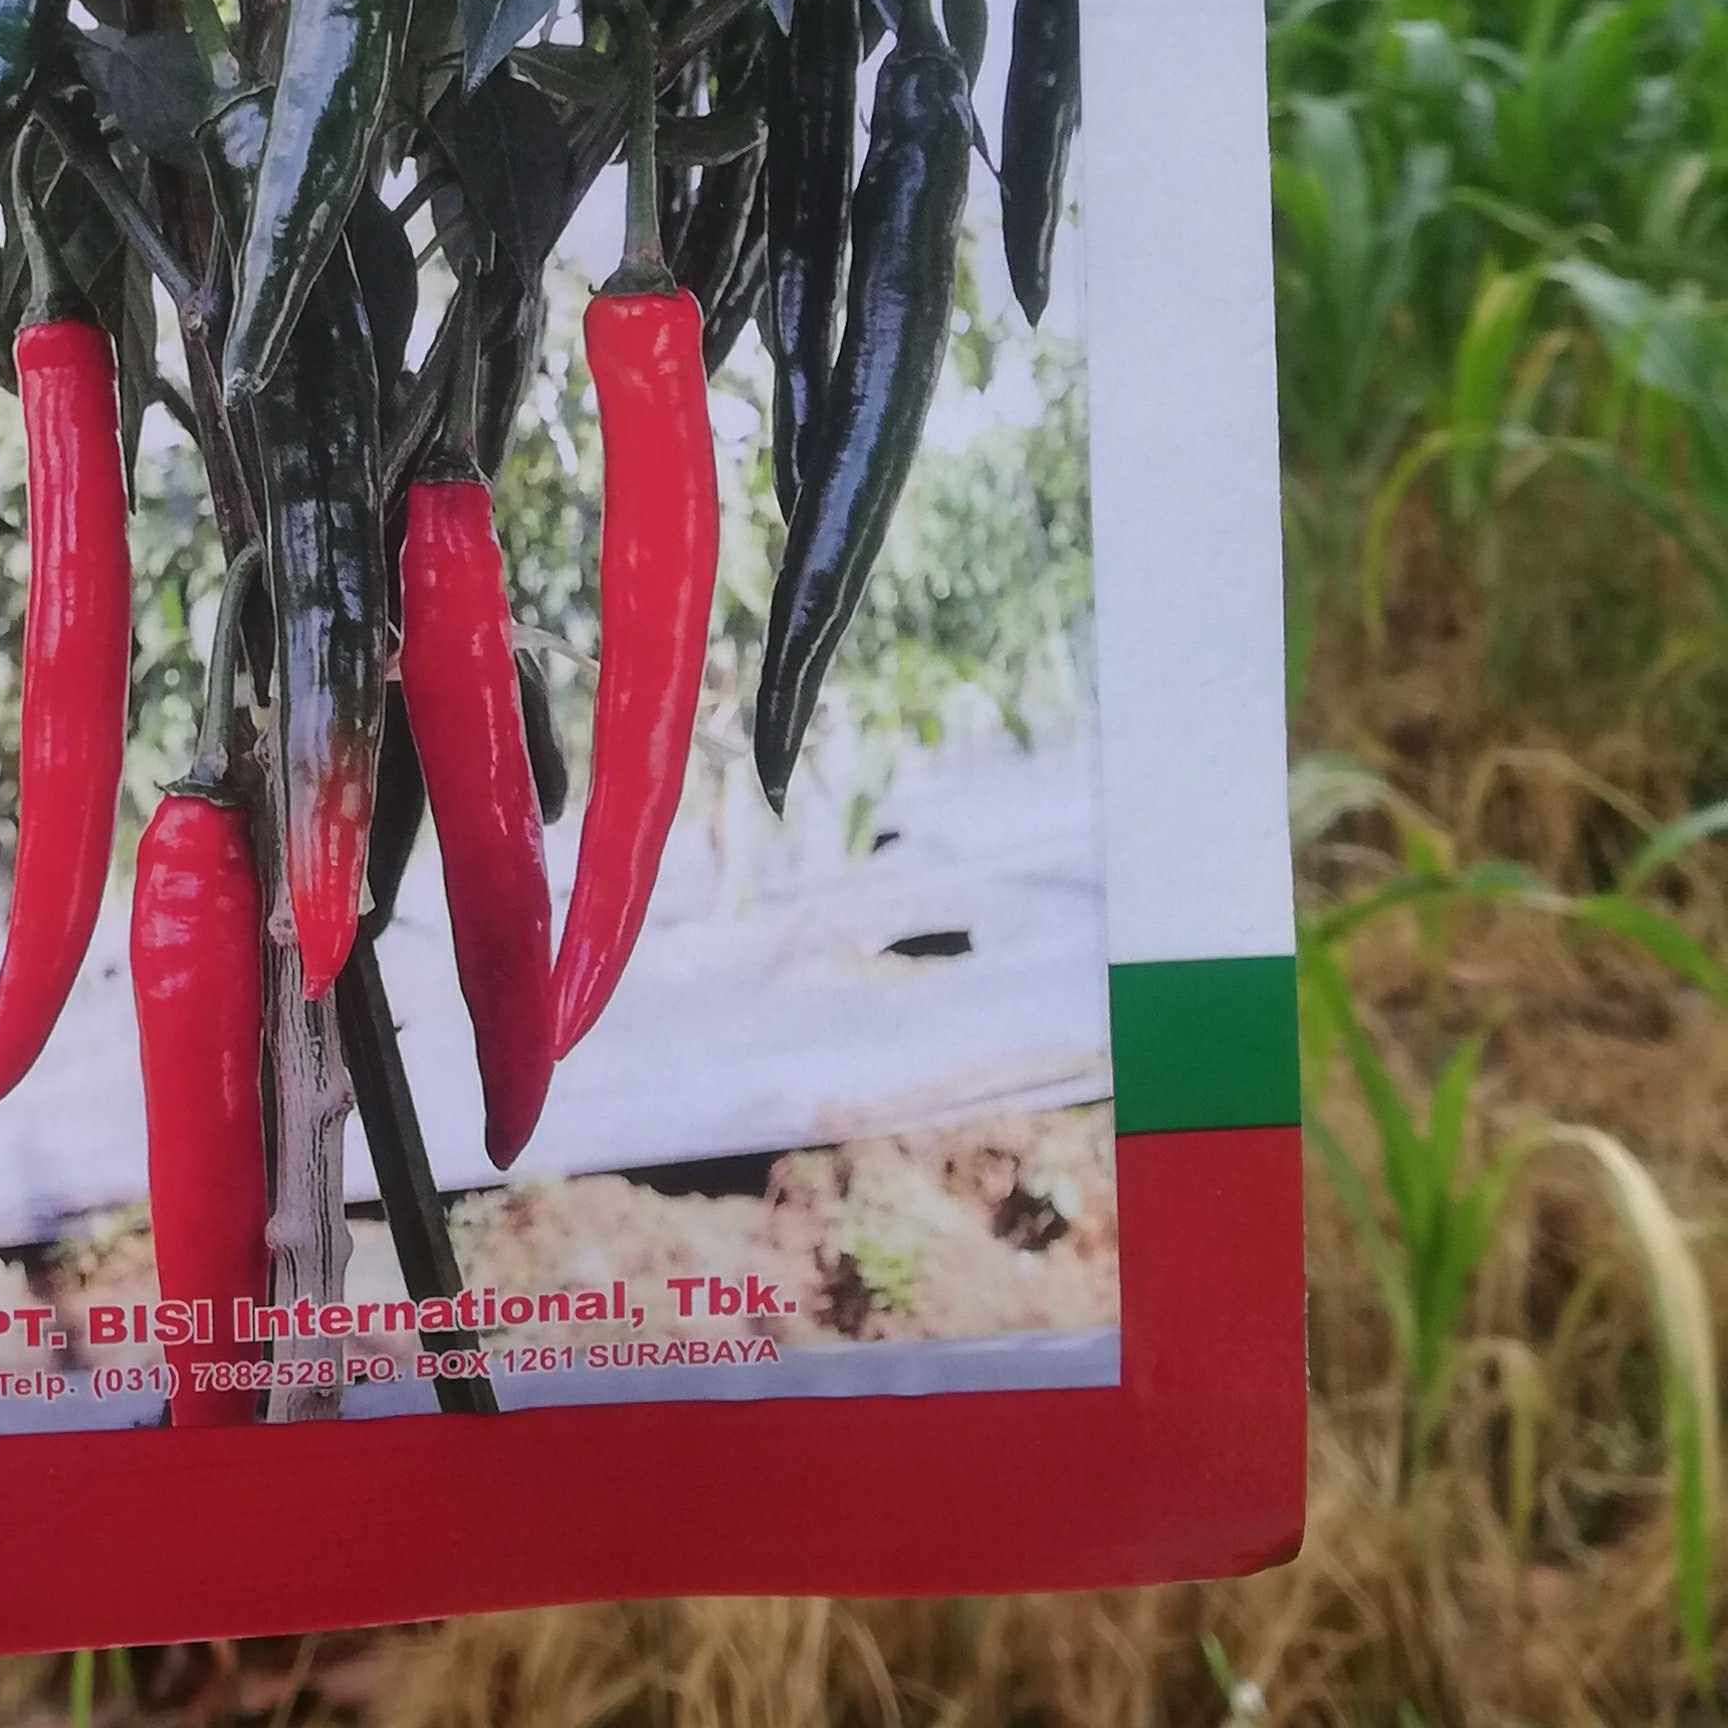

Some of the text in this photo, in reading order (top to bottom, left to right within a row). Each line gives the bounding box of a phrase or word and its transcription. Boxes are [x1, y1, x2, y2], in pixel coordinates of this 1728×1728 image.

[87, 1299, 214, 1346] BISI
[233, 1277, 645, 1342] International,
[666, 1274, 798, 1317] Tbk.
[91, 1366, 180, 1401] (031)
[190, 1356, 336, 1393] 7882528
[344, 1355, 405, 1384] PO.
[414, 1349, 491, 1380] BOX
[501, 1345, 575, 1375] 1261
[585, 1337, 781, 1371] SURABAYA
